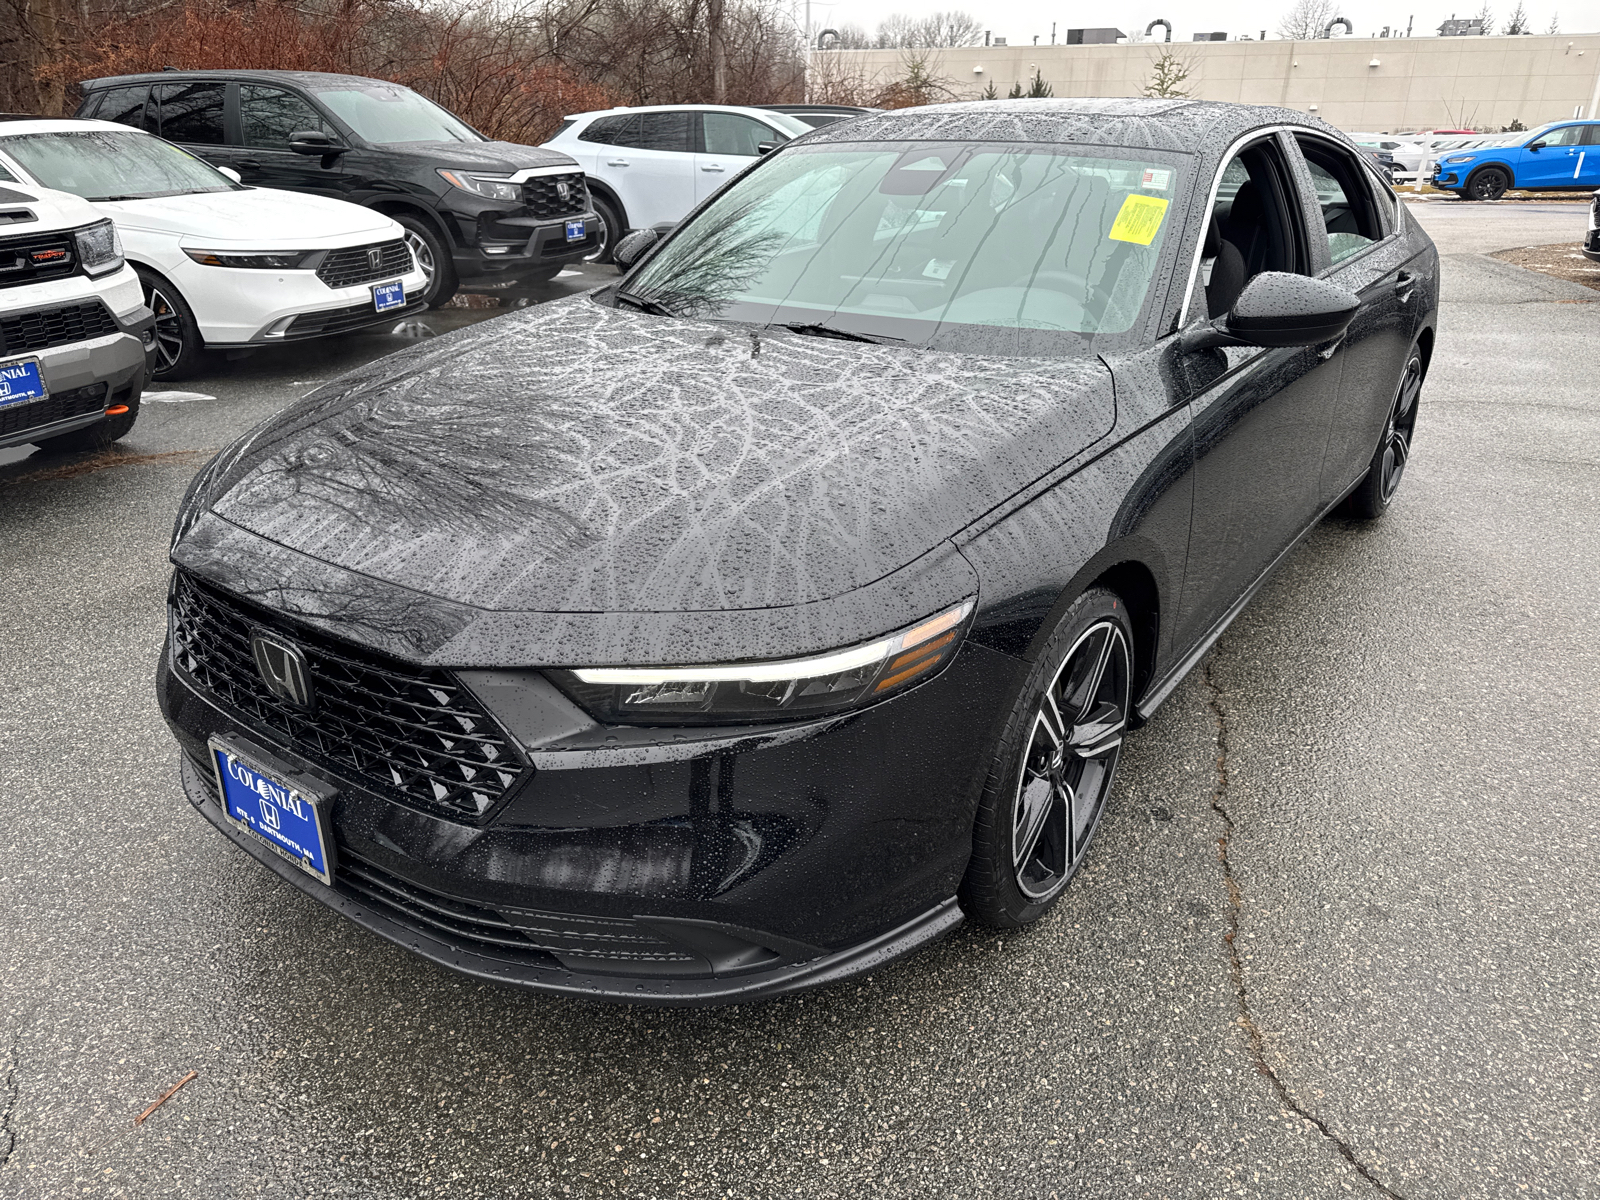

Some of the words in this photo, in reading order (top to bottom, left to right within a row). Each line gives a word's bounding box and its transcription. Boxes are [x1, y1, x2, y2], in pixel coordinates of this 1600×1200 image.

[0, 366, 30, 382] NIAL
[227, 755, 308, 821] COLONIAL
[259, 821, 303, 855] DARTMOUTH,
[303, 848, 315, 861] MA
